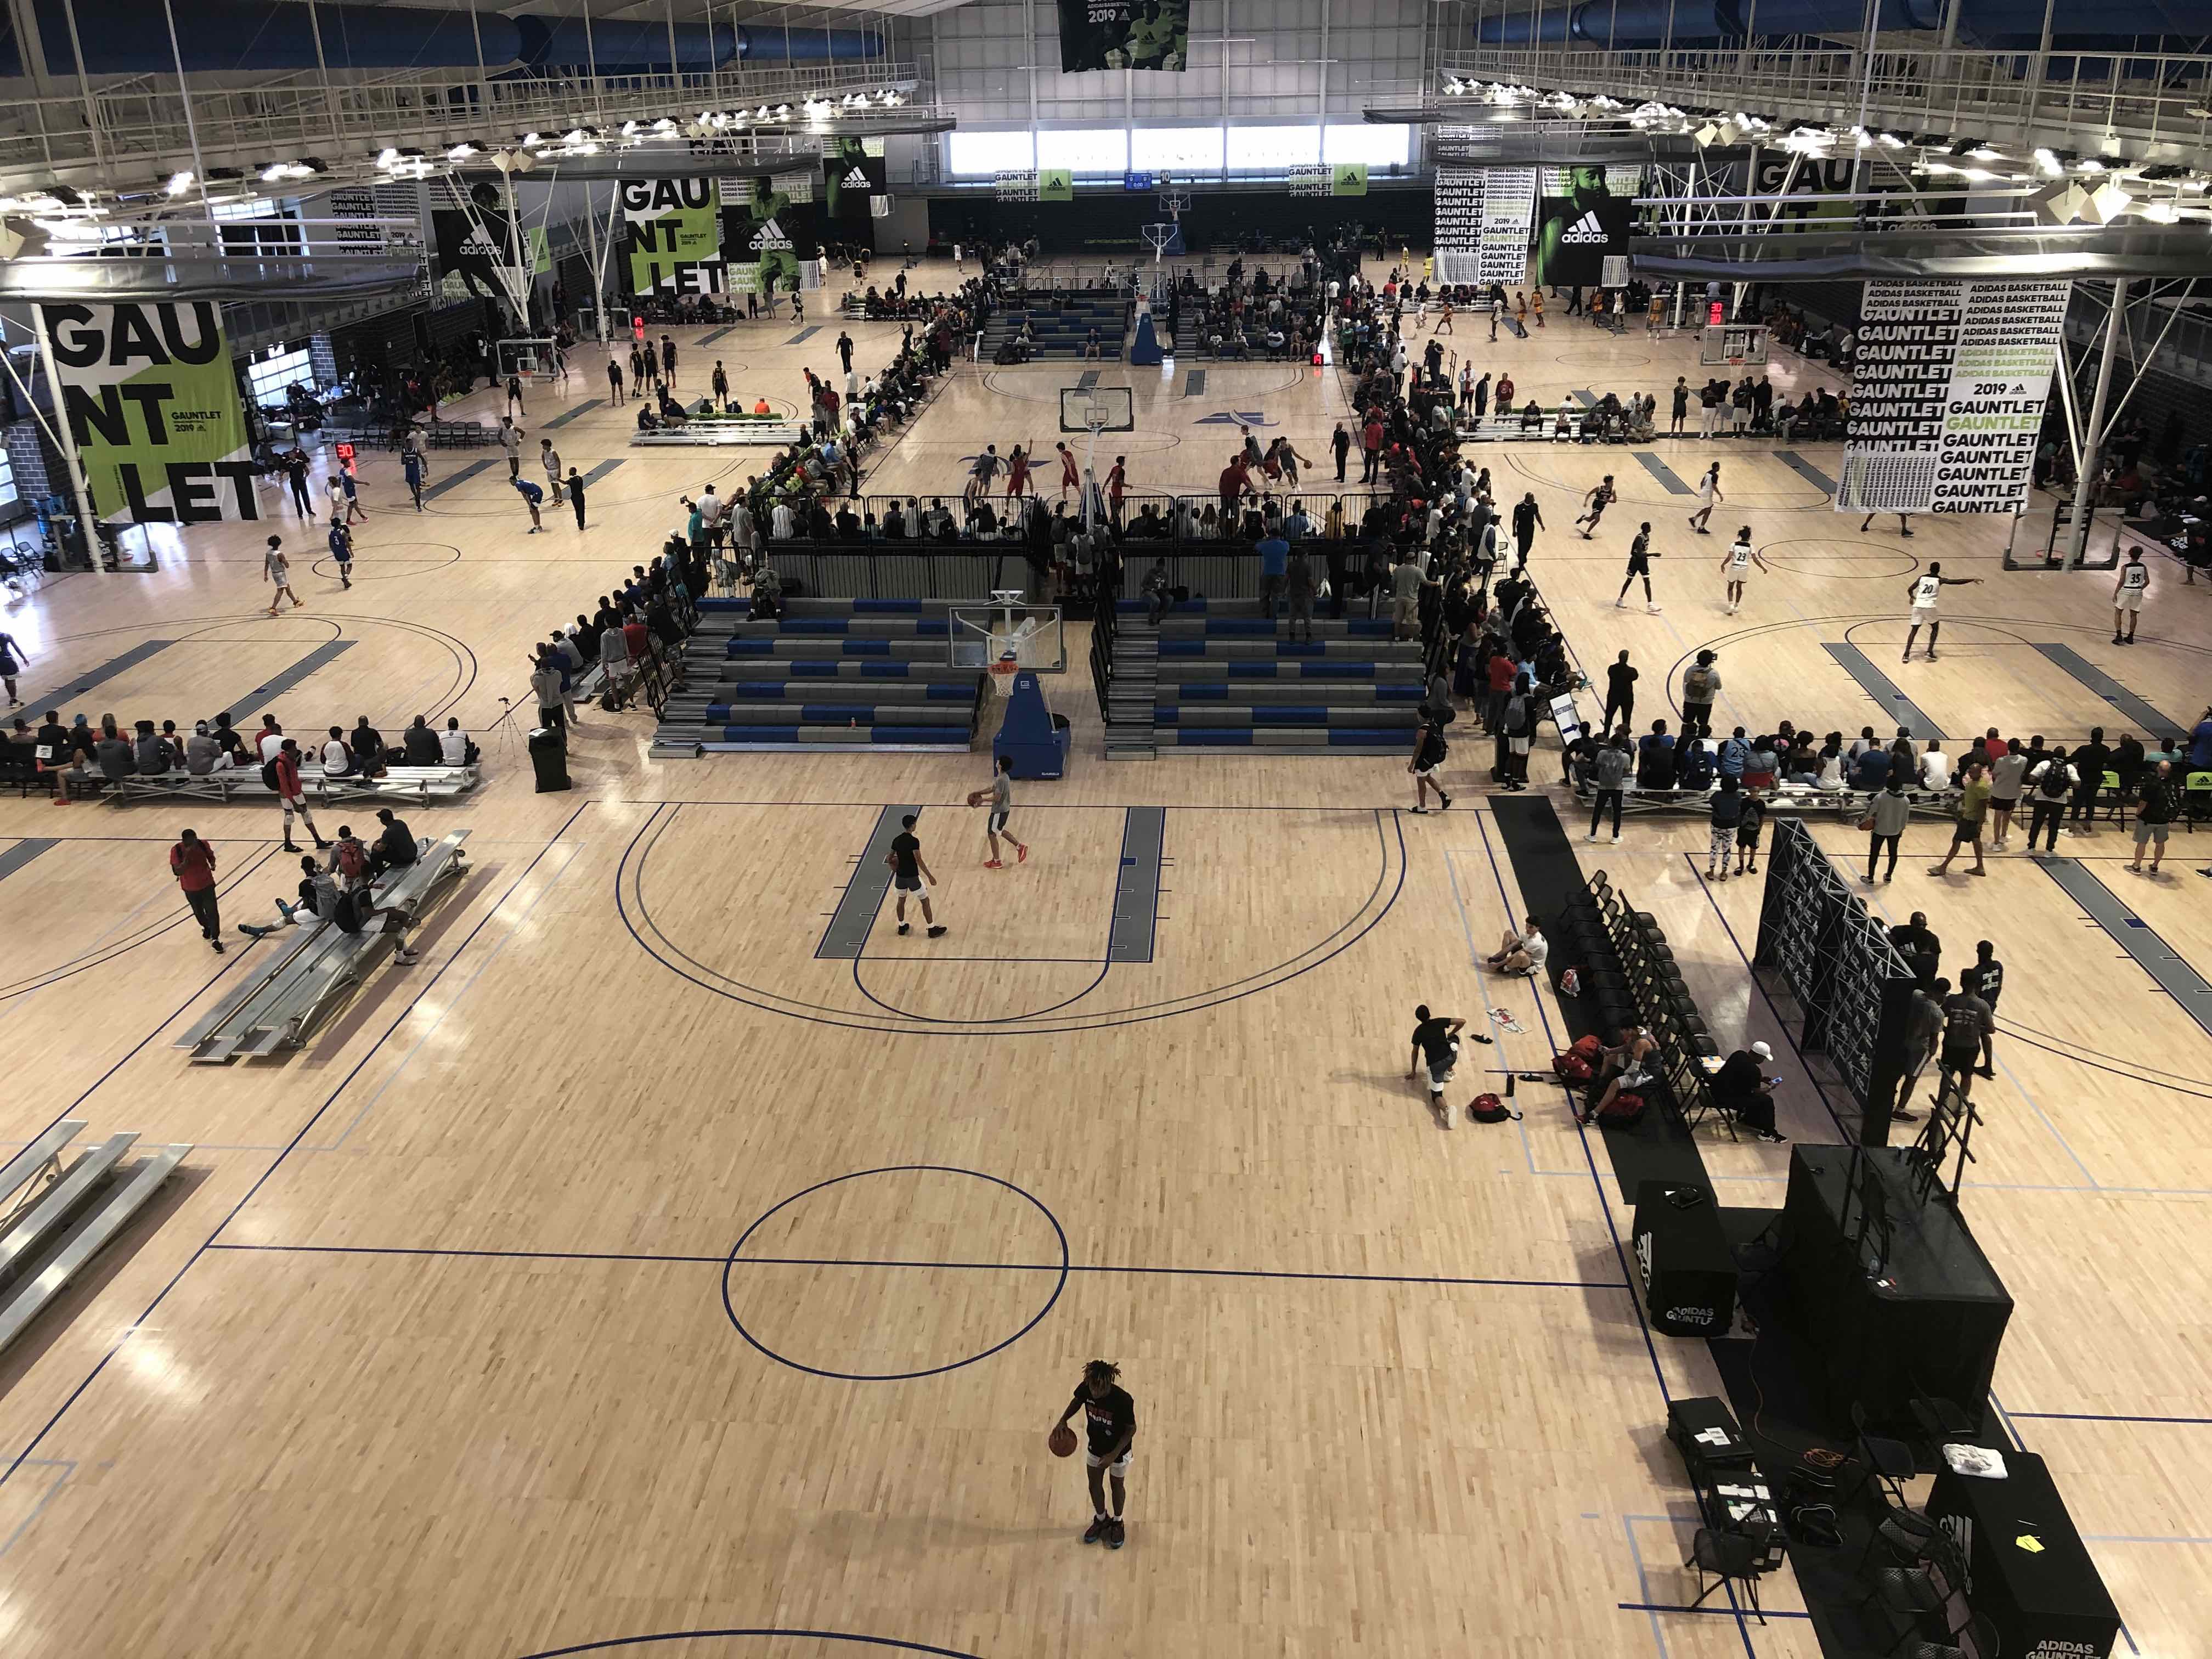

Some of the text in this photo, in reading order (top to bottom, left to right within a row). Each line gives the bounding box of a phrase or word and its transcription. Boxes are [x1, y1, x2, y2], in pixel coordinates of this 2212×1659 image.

[1088, 9, 1116, 23] 2019
[1161, 172, 1170, 182] 10
[1757, 159, 1853, 193] GAU
[620, 178, 710, 211] GAU
[1435, 217, 1482, 225] GAUNTLET
[626, 219, 683, 253] NT
[1562, 232, 1609, 243] adidas
[749, 238, 793, 250] adidas
[650, 261, 721, 295] LET
[1711, 303, 1722, 312] 30
[1860, 309, 1960, 321] GAUNTLET
[43, 302, 221, 368] GAU
[1858, 325, 1959, 341] GAUNTLET
[1855, 345, 1957, 360] GAUNTLET
[1854, 364, 1953, 379] GAUNTLET
[1852, 383, 1949, 398] GAUNTLET
[1973, 383, 2007, 395] 2019
[1849, 402, 1946, 417] GAUNTLET
[1949, 400, 2045, 414] GAUNTLET
[63, 383, 174, 446] NT
[171, 411, 222, 420] GAUNTLET
[1847, 420, 1942, 436] GAUNTLET
[1947, 416, 2043, 430] GAUNTLET
[1844, 439, 1939, 452] GAUNTLET
[1943, 433, 2038, 447] GAUNTLET
[337, 444, 353, 457] 30
[1940, 449, 2033, 464] GAUNTLET
[1938, 466, 2030, 481] GAUNTLET
[119, 461, 259, 523] LET
[1934, 483, 2027, 497] GAUNTLET
[1932, 500, 2025, 514] GAUNTLET
[334, 536, 340, 545] 3
[1736, 552, 1747, 562] 23
[2131, 573, 2141, 583] 35
[1922, 584, 1933, 594] 20
[1731, 747, 1745, 757] 23
[2036, 1640, 2094, 1654] ADIDAS
